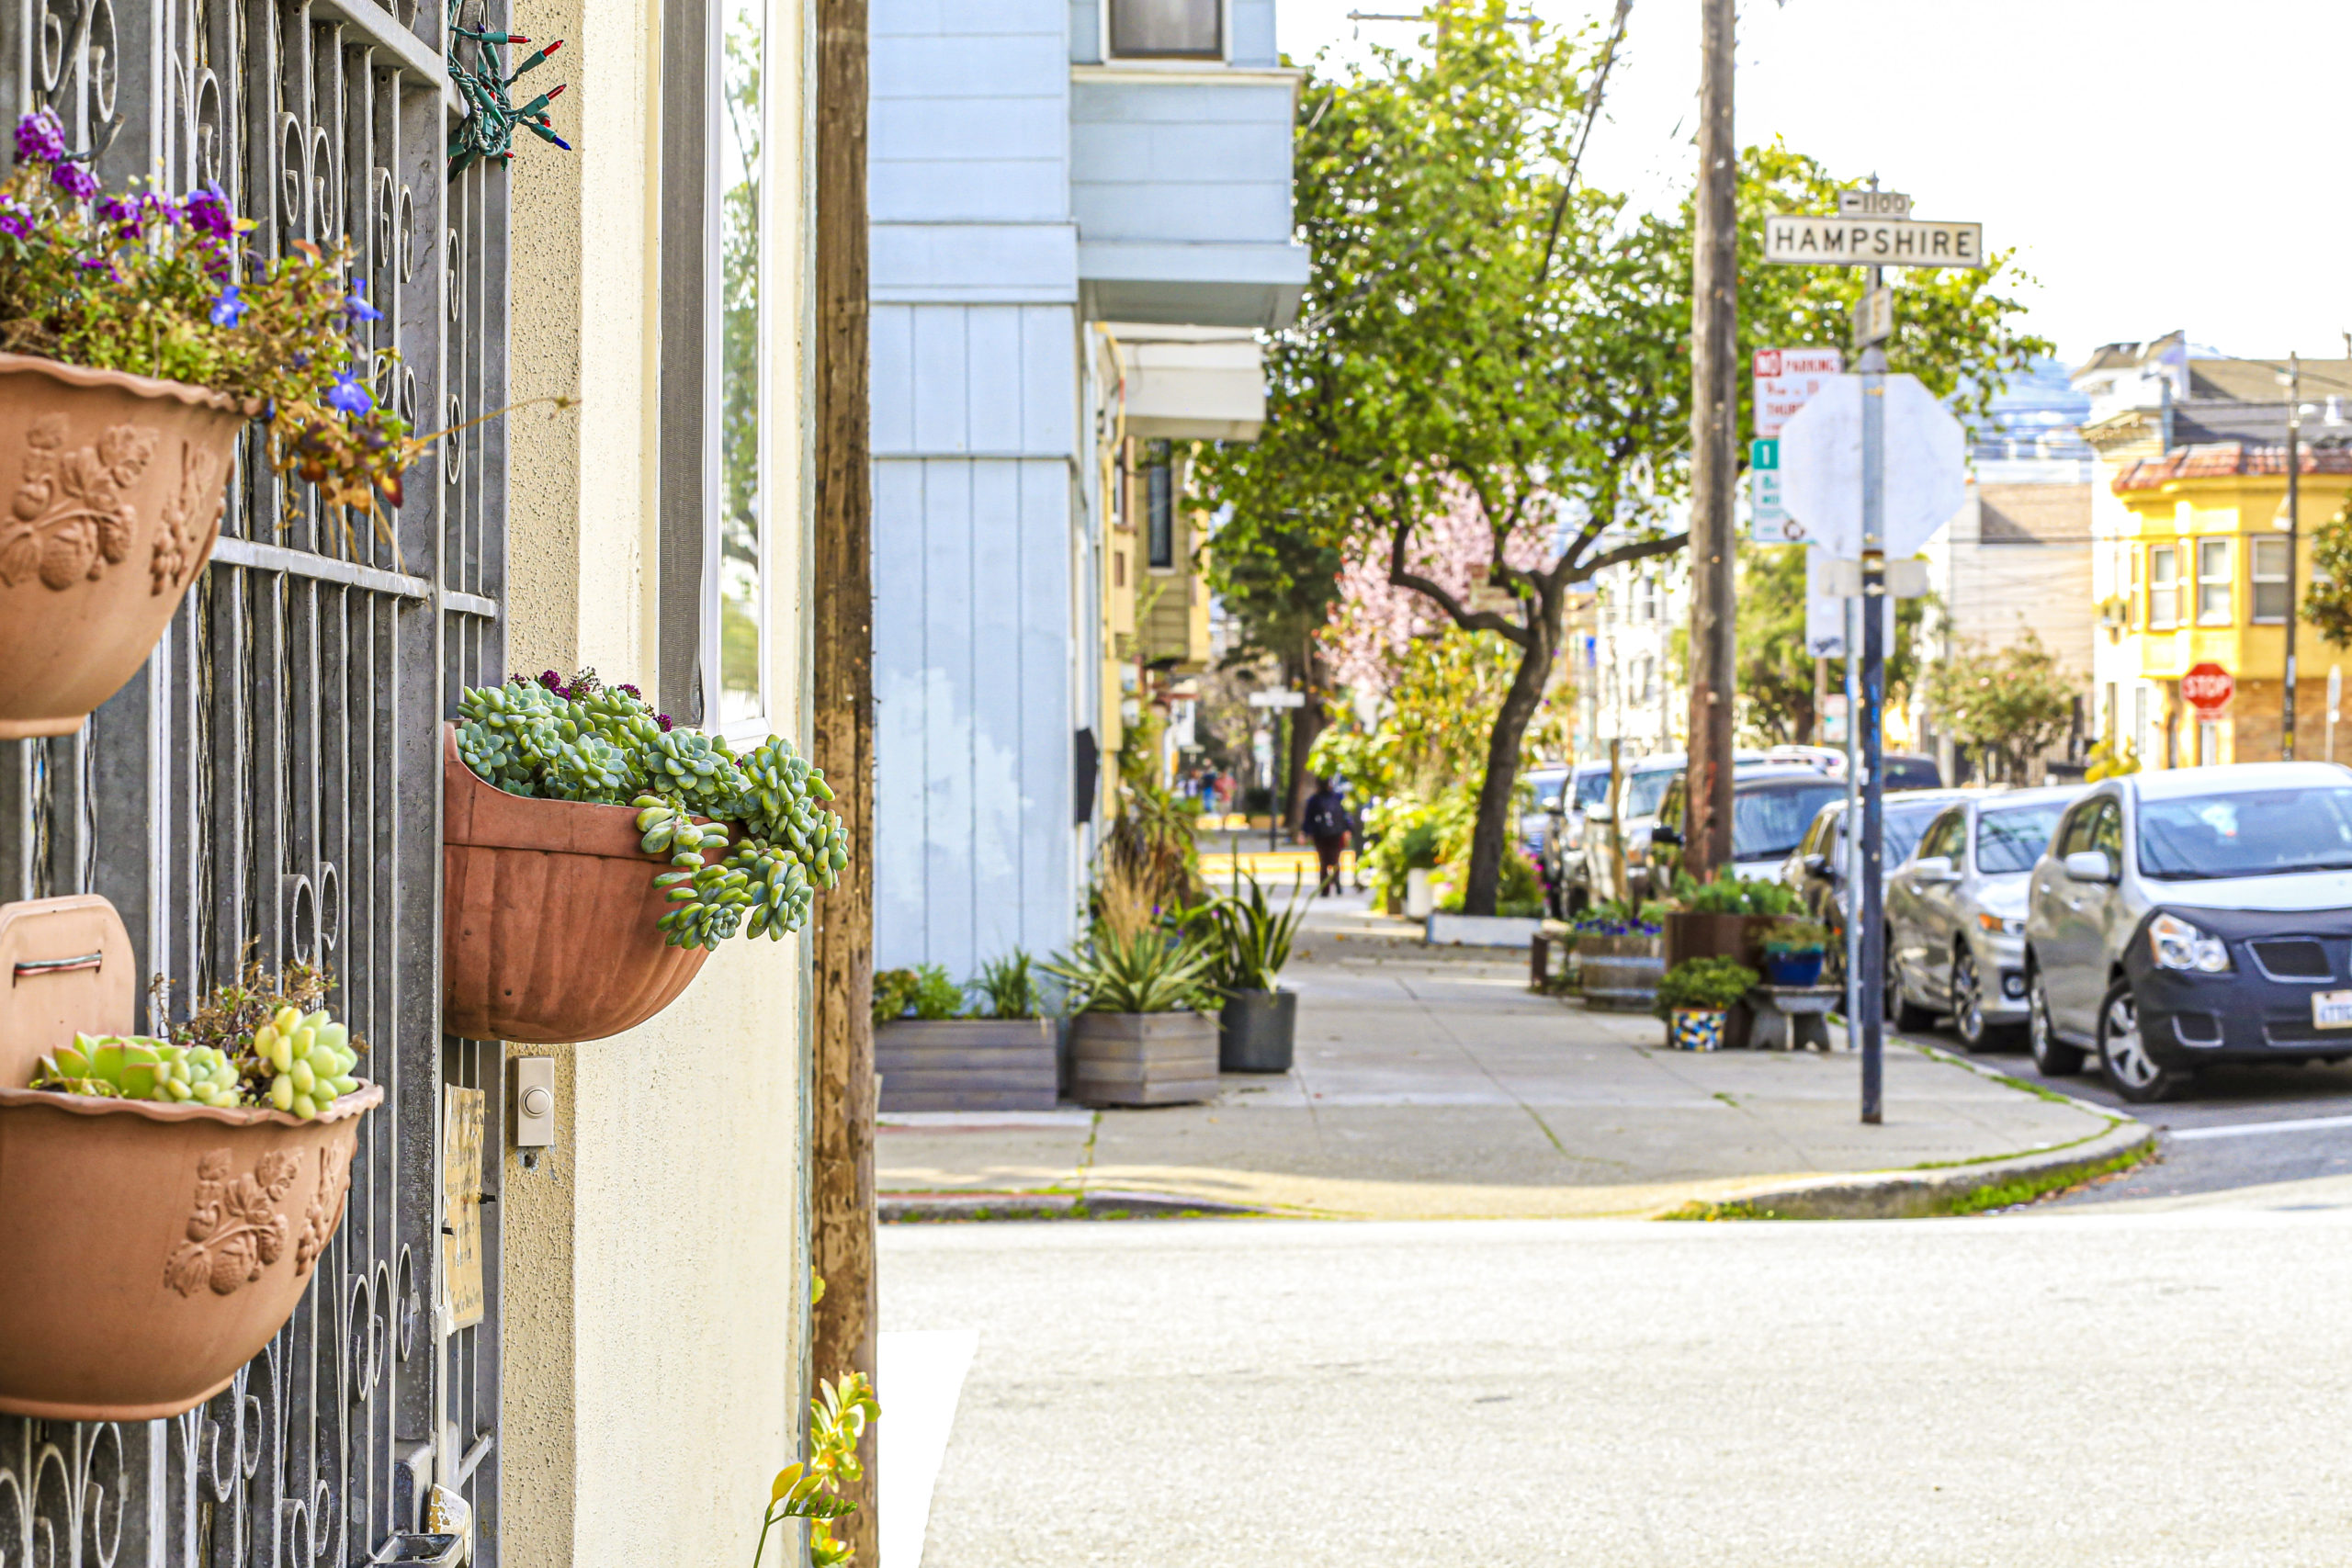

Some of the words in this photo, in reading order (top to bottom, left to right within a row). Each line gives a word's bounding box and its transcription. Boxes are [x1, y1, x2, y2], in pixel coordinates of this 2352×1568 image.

[1863, 193, 1905, 214] 1100
[1775, 226, 1973, 257] HAMPSHIRE
[1757, 354, 1781, 375] NO
[1786, 359, 1834, 373] PARKING
[2185, 675, 2231, 697] STOP
